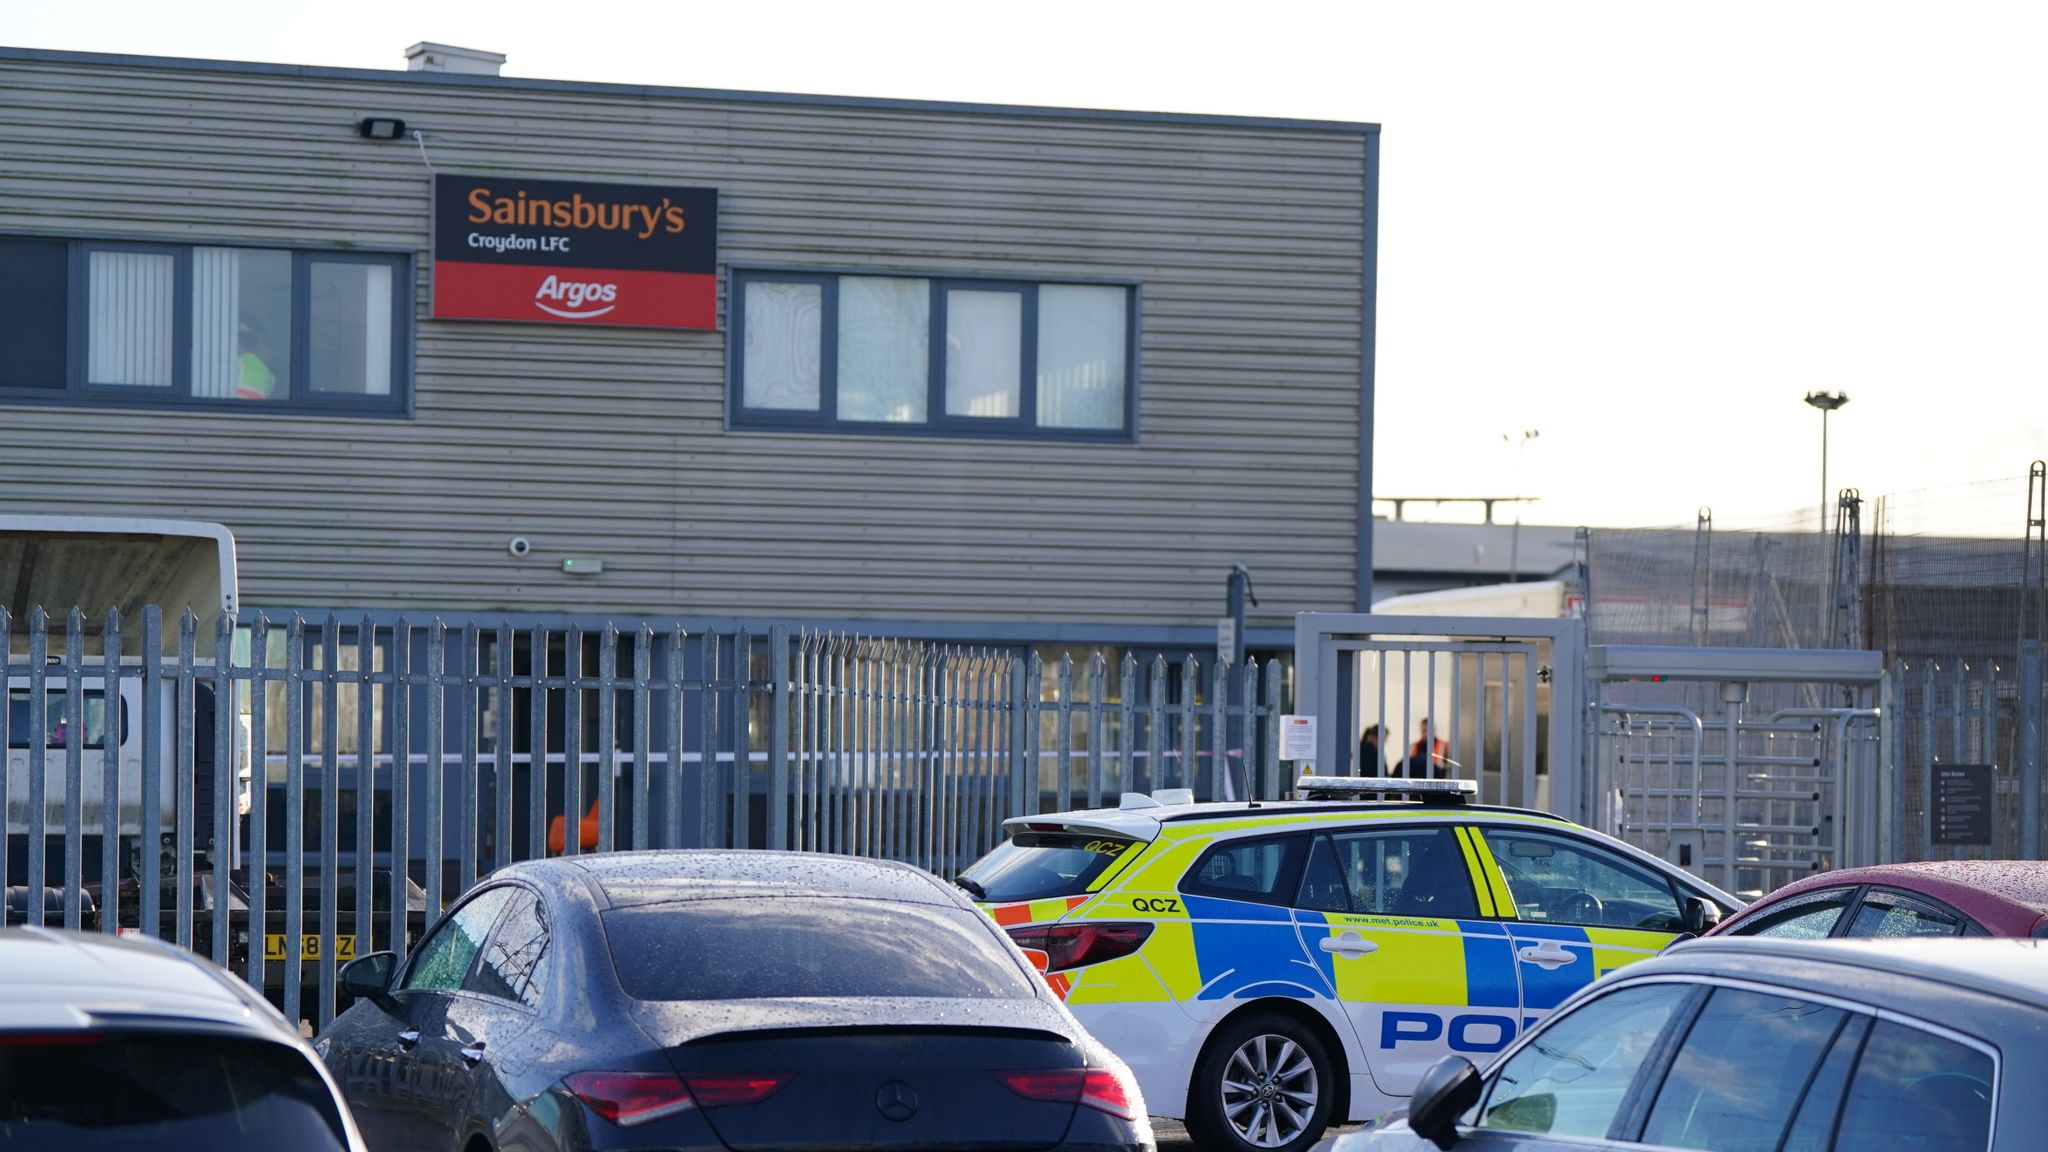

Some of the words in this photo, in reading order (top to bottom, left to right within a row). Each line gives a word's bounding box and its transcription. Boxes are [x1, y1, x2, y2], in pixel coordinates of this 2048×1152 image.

[467, 188, 685, 239] Sainsbury's
[468, 232, 536, 253] Croydon
[540, 236, 570, 252] LFC
[535, 275, 617, 307] Argos
[1084, 840, 1125, 857] QCZ
[1132, 898, 1180, 912] QCZ
[1344, 917, 1439, 928] www.met.police.uk
